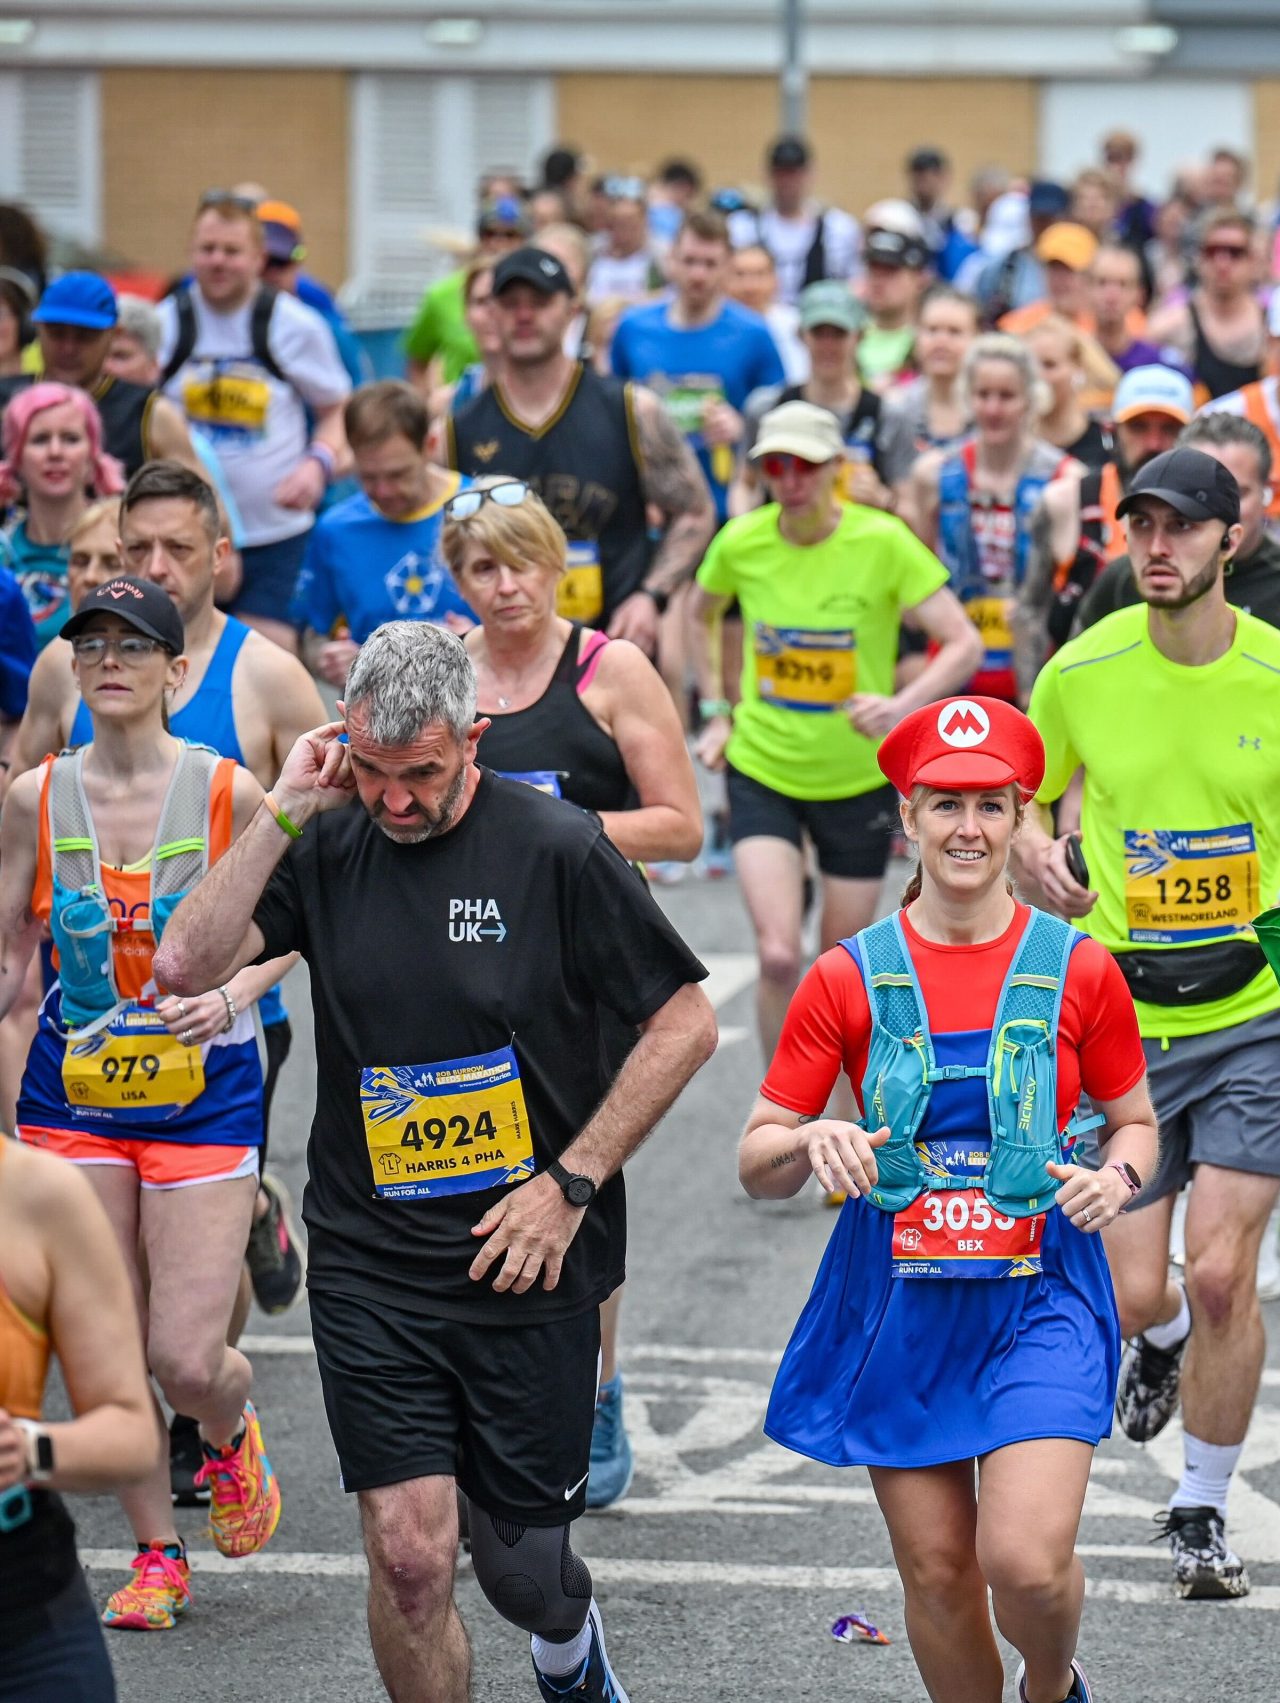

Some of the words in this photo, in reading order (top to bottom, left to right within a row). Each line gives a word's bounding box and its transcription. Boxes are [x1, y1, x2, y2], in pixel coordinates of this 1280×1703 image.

[943, 709, 985, 736] M
[1157, 874, 1231, 905] 1258
[449, 899, 501, 919] PHA
[1151, 908, 1238, 923] WESTMORELAND
[448, 922, 482, 942] UK
[101, 1053, 161, 1084] 979
[436, 1070, 451, 1078] ROB
[453, 1064, 484, 1076] BURROW
[436, 1074, 461, 1085] LEEDS
[463, 1062, 511, 1081] MARATHON
[489, 1071, 512, 1083] Clarion
[121, 1091, 147, 1101] LISA
[400, 1110, 498, 1152] 4924
[406, 1157, 457, 1174] HARRIS
[461, 1155, 471, 1166] 4
[475, 1149, 505, 1164] PHA
[383, 1190, 400, 1198] RUN
[401, 1188, 416, 1196] FOR
[417, 1187, 431, 1195] ALL
[907, 1235, 914, 1246] S
[957, 1239, 984, 1251] BEX
[898, 1266, 914, 1274] RUN
[914, 1266, 928, 1274] FOR
[929, 1266, 943, 1274] ALL
